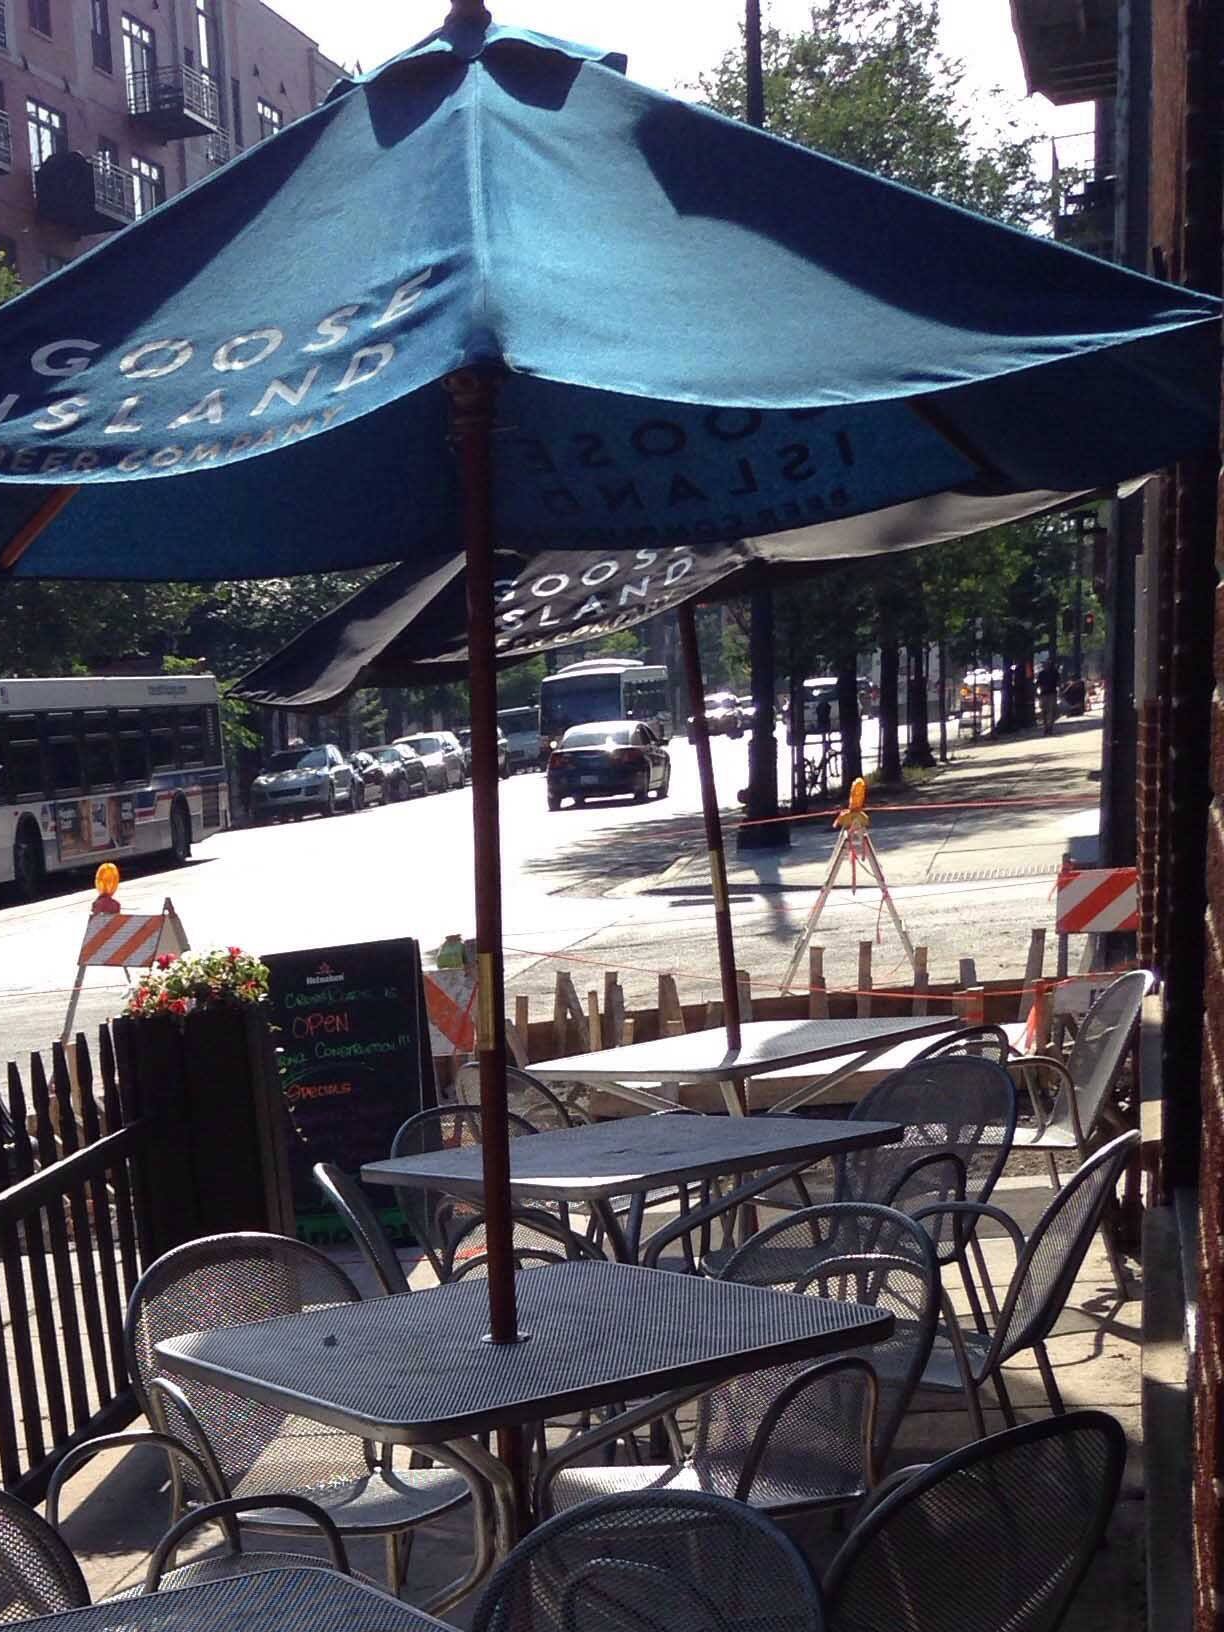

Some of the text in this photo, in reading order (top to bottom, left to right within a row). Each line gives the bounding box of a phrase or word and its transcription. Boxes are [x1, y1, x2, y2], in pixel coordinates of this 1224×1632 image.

[29, 266, 433, 379] GOOSE
[117, 404, 345, 473] COMPANY
[493, 546, 691, 603] GOOS
[500, 556, 693, 632] SLAND
